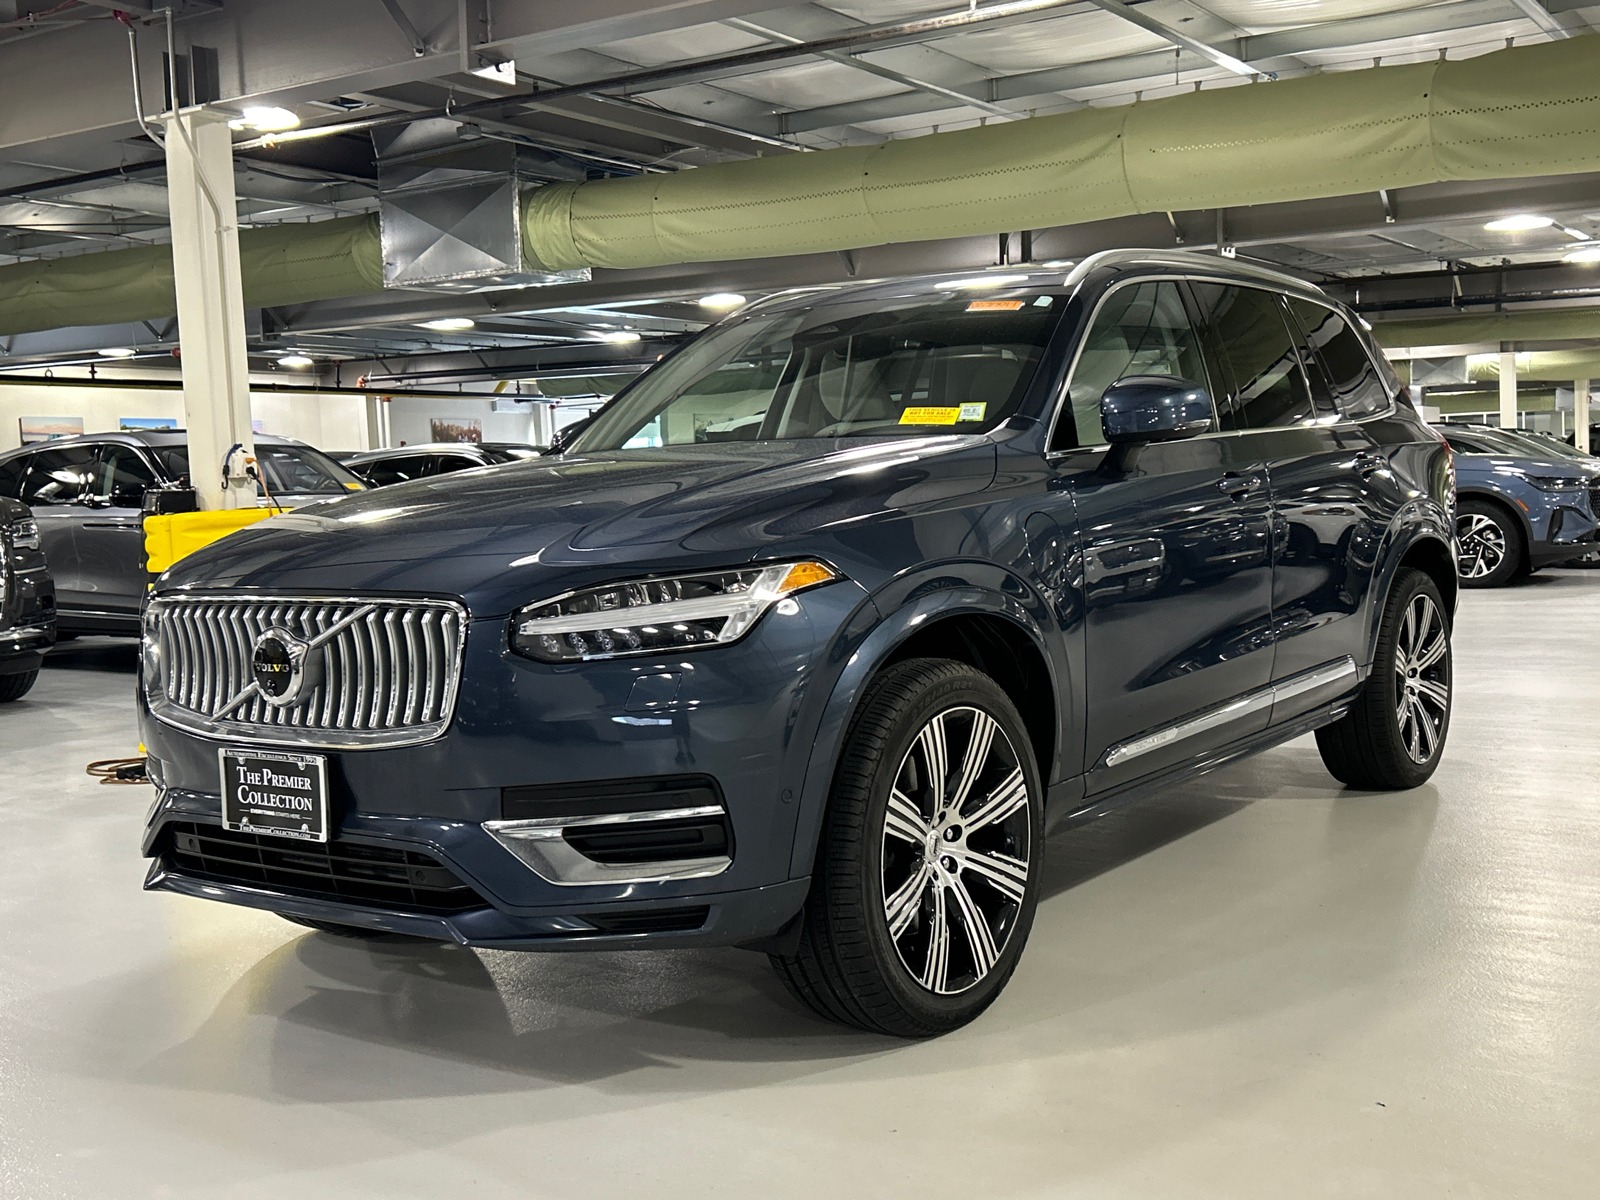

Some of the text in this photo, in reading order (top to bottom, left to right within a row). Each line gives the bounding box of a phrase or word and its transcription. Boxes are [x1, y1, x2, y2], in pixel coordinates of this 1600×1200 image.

[236, 766, 312, 790] THE PREMIER
[237, 785, 313, 811] COLLECTION
